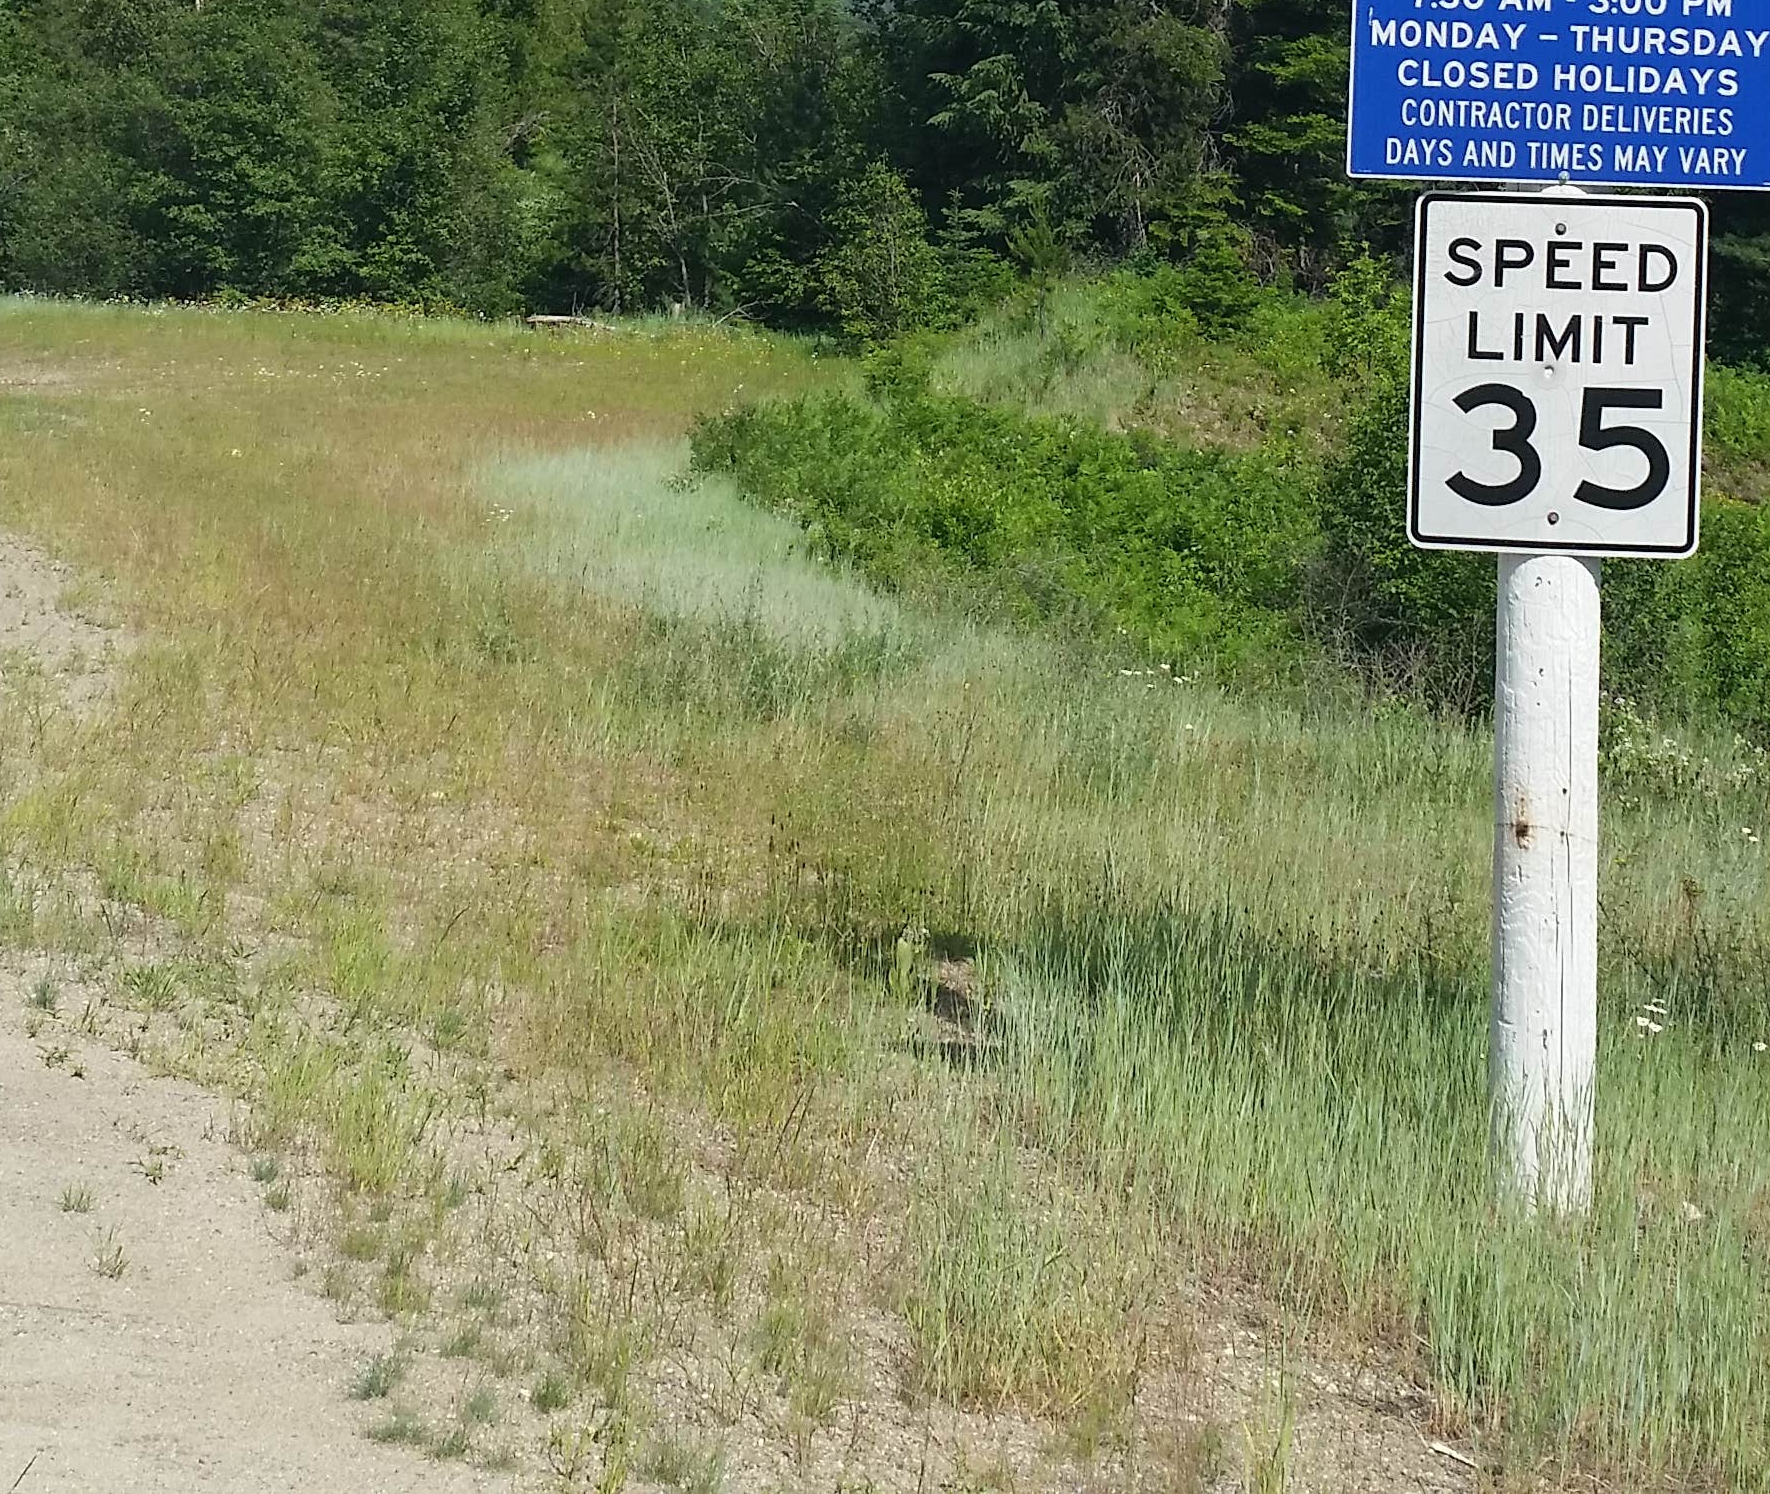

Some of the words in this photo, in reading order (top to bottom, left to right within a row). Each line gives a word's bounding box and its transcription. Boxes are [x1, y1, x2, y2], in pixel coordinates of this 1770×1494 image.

[1370, 20, 1527, 50] MONDAY
[1570, 25, 1770, 57] THURSDAY
[1398, 59, 1538, 90] CLOSED
[1554, 64, 1739, 96] HOLIDAYS
[1402, 99, 1571, 131] CONTRACTOR
[1582, 105, 1734, 136] DELIVERIES
[1386, 137, 1453, 167] DAYS
[1463, 141, 1516, 168] AND
[1527, 142, 1603, 171] TIMES
[1614, 145, 1669, 172] MAY
[1679, 147, 1747, 175] VARY
[1444, 238, 1678, 292] SPEED
[1467, 311, 1649, 365] LIMIT
[1444, 383, 1670, 511] 35
